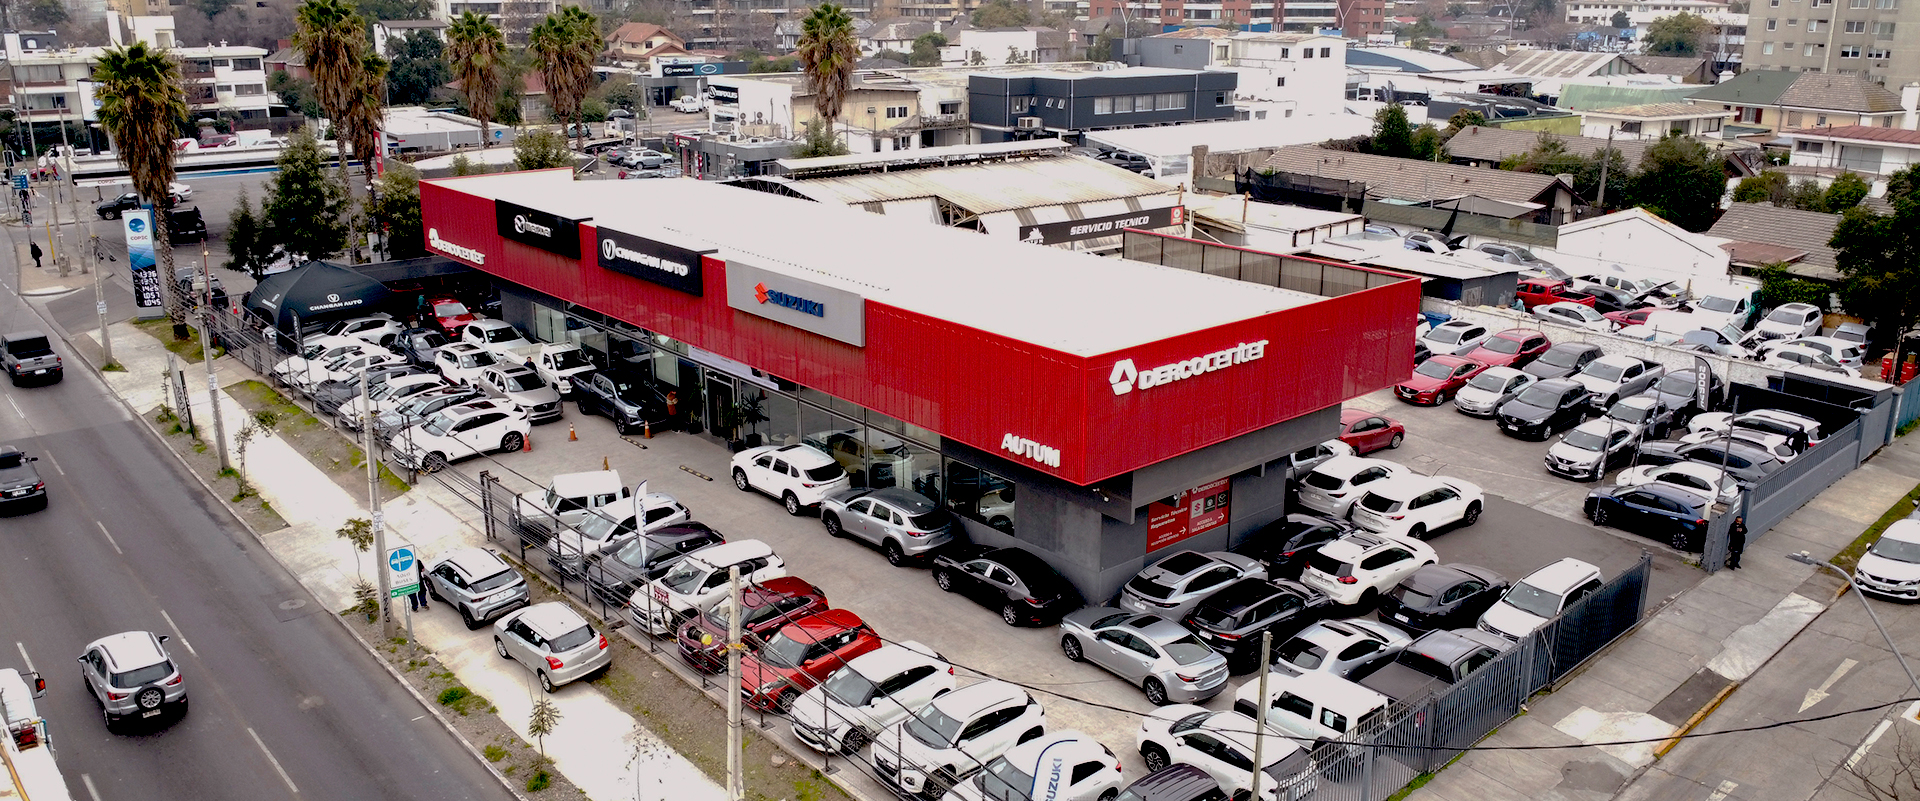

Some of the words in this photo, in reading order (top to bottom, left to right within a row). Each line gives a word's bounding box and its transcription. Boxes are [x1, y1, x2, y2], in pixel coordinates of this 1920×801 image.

[1069, 221, 1113, 236] SERVICIO
[343, 299, 363, 307] AUTO
[767, 289, 824, 318] SUZUKI
[1001, 432, 1061, 468] AUTUM
